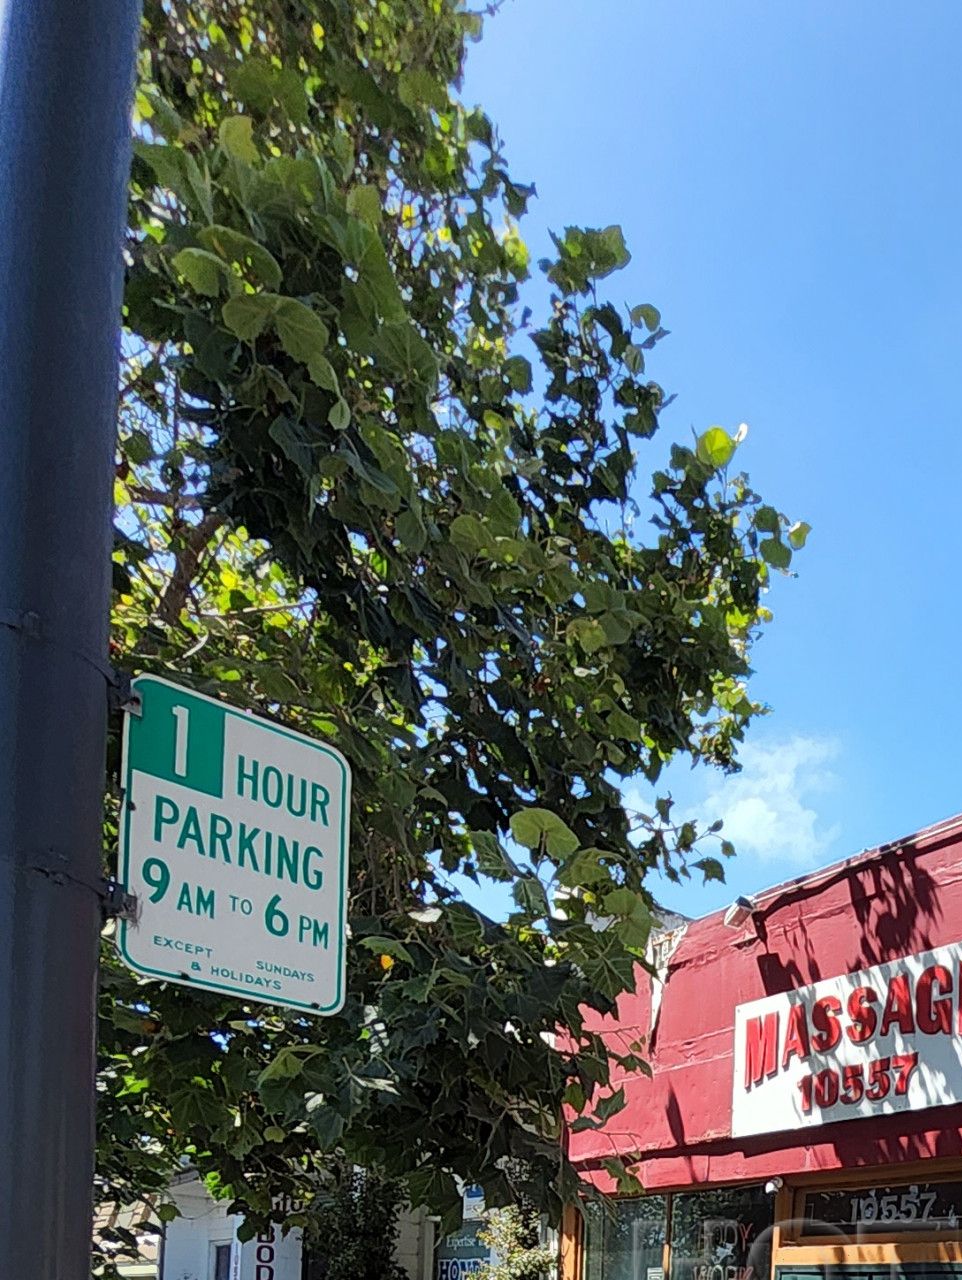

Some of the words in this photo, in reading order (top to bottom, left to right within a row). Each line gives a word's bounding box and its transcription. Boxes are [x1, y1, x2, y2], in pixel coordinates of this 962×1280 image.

[172, 705, 190, 778] 1
[237, 754, 331, 827] HOUR
[154, 795, 324, 891] PARKING
[229, 894, 253, 916] TO
[153, 934, 214, 958] EXCEPT
[256, 960, 315, 983] SUNDAYS
[190, 960, 202, 972] &
[210, 965, 283, 991] HOLIDAYS
[797, 1052, 919, 1116] 10557
[850, 1191, 937, 1225] 10557
